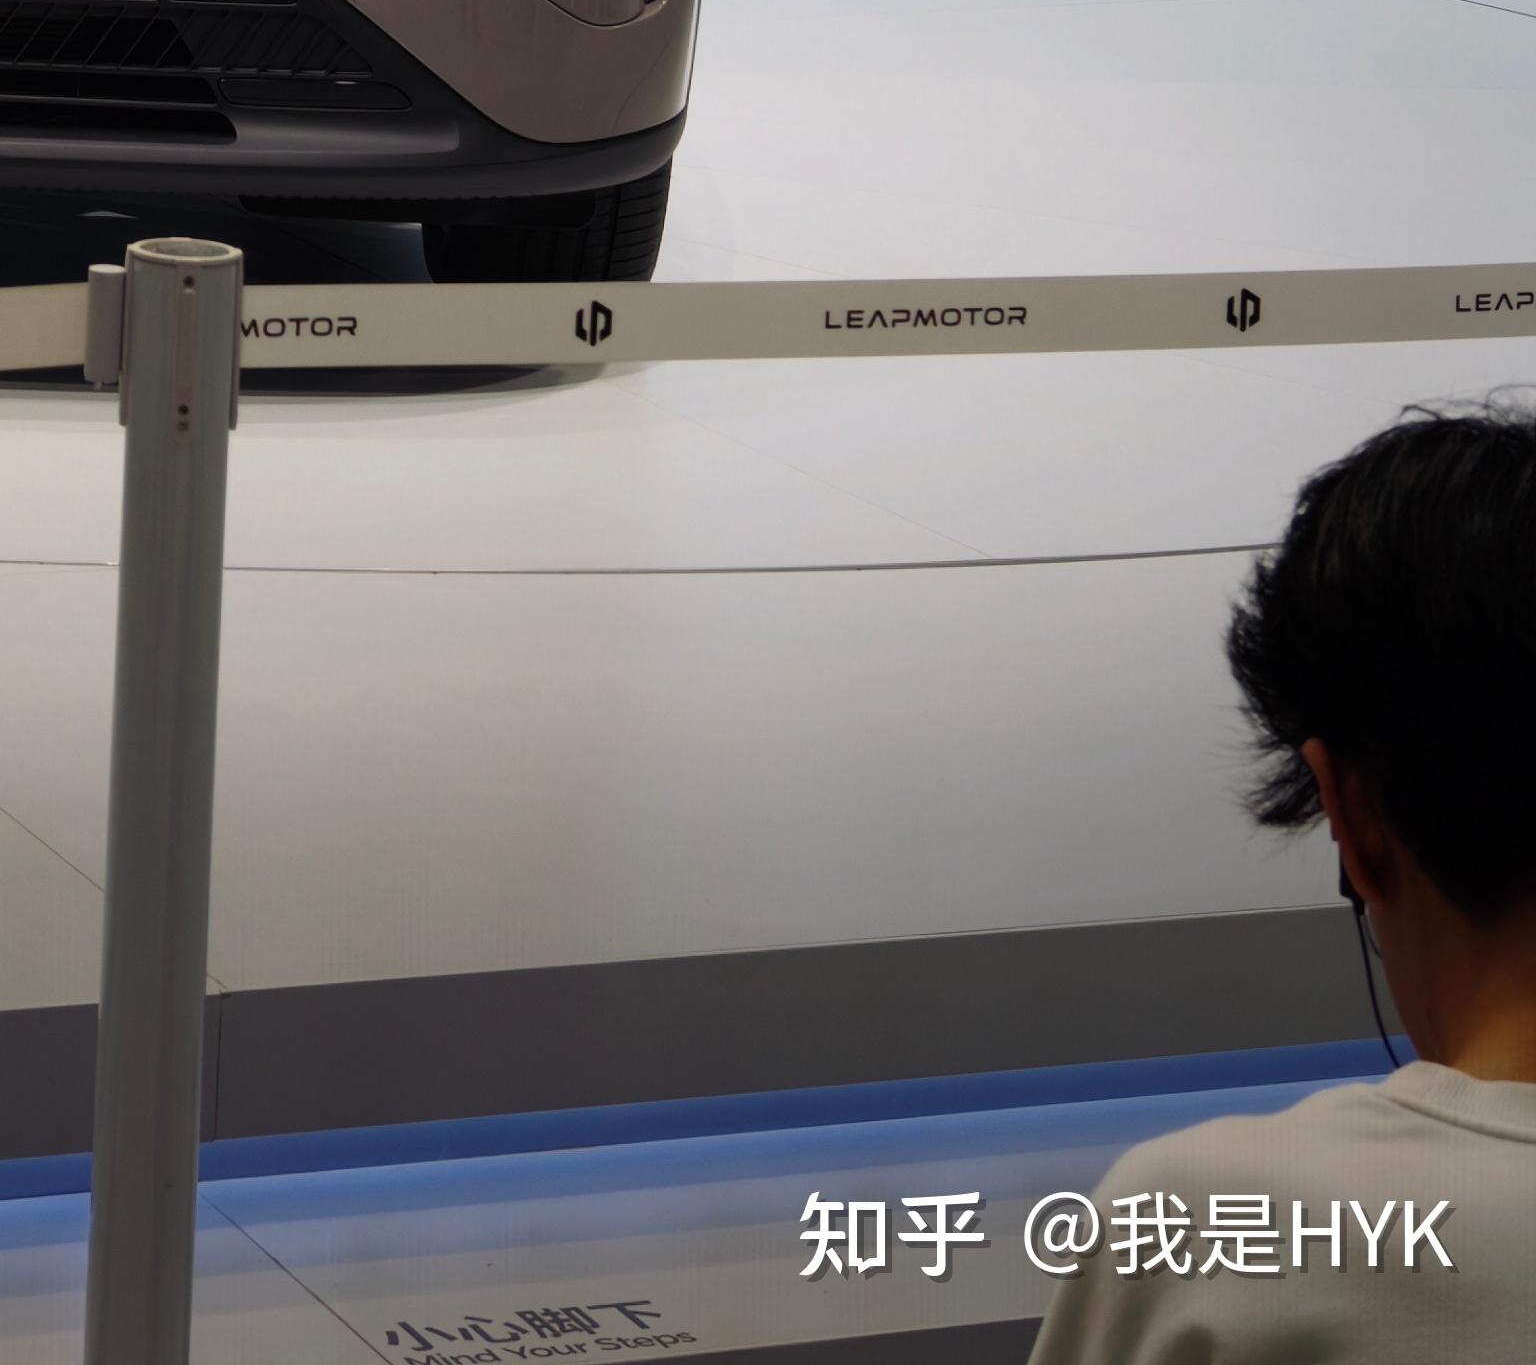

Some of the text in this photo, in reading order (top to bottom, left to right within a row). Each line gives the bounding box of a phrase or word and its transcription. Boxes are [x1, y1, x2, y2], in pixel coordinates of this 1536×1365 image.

[1455, 291, 1536, 313] LEAP
[241, 316, 358, 338] MOTOR
[824, 306, 1028, 330] LEAPMOTOR
[385, 1300, 662, 1352] 小心脚下
[501, 1342, 589, 1360] Your
[594, 1332, 698, 1351] Steps
